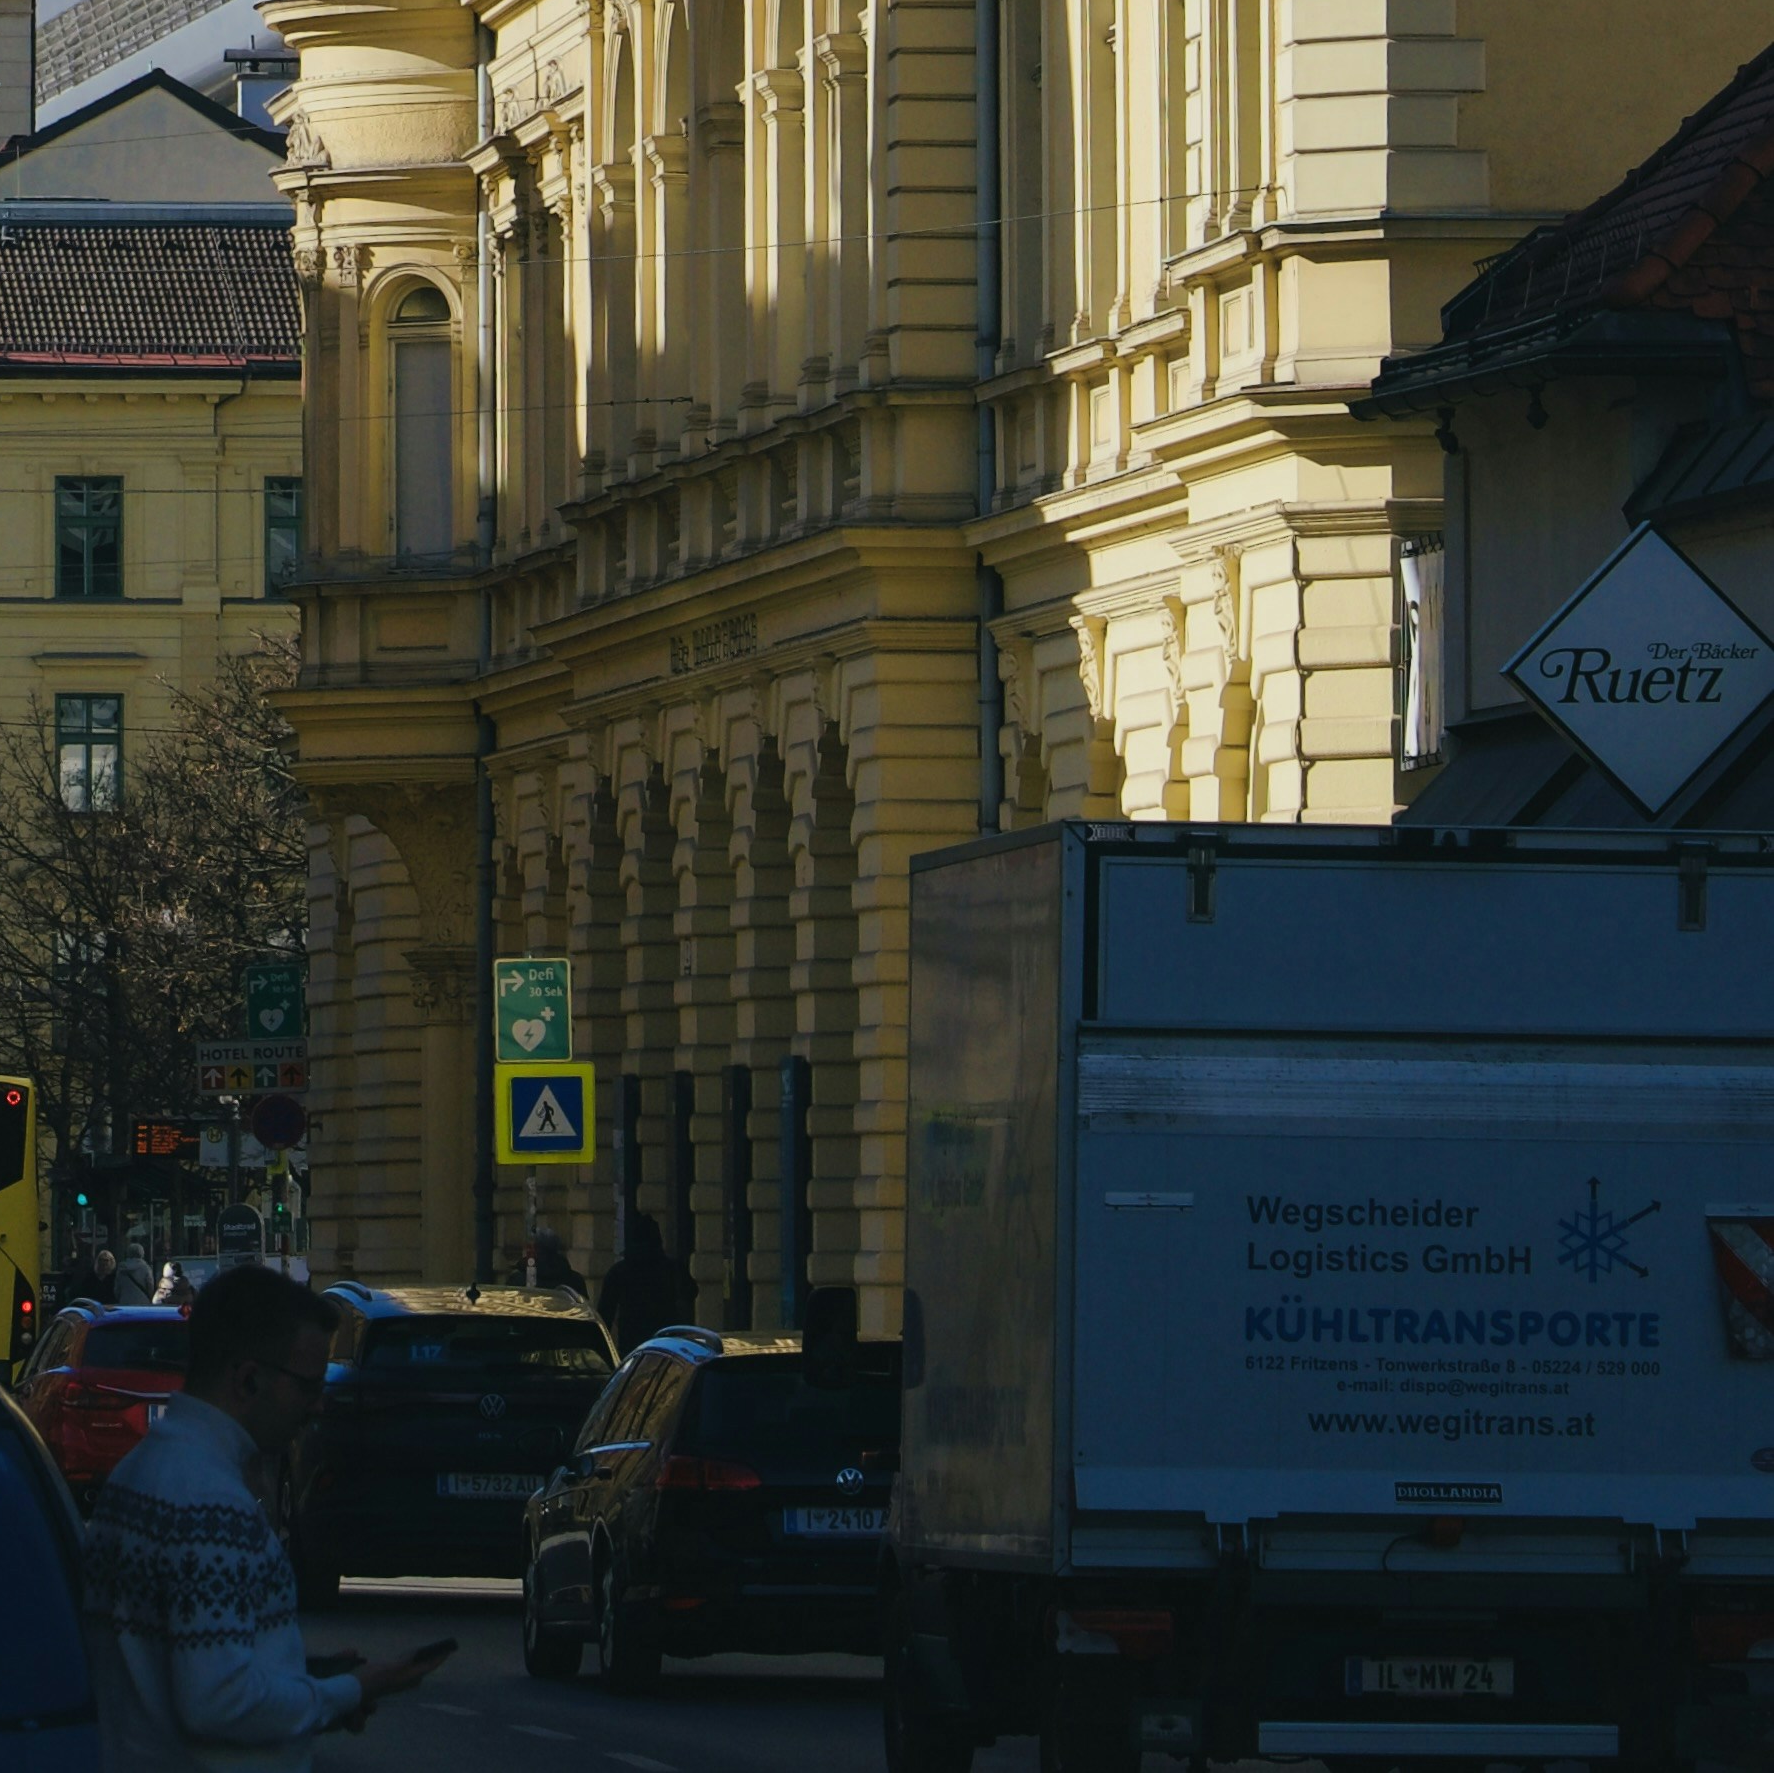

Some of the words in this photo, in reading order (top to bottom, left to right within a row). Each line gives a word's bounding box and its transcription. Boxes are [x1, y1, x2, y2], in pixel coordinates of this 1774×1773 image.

[1647, 642, 1688, 660] Der
[1691, 642, 1759, 660] Bäcker
[1539, 647, 1724, 704] Ruetz
[528, 966, 555, 981] Defi
[529, 986, 543, 998] 30
[544, 986, 563, 997] Sek
[200, 1048, 249, 1061] HOTEL
[253, 1046, 304, 1060] ROUTE
[1246, 1195, 1479, 1233] Wegscheider
[1247, 1242, 1409, 1279] Logistics
[1422, 1244, 1532, 1275] GmbH
[1245, 1294, 1660, 1348] KÜHLTRANSPORTE
[1245, 1355, 1285, 1371] 6122
[1290, 1356, 1359, 1371] Fritzens
[1375, 1357, 1501, 1374] Tonwerkstraße
[1506, 1359, 1516, 1374] 8
[1532, 1359, 1582, 1375] 05224
[1585, 1360, 1592, 1375] /
[1596, 1360, 1626, 1376] 529
[1630, 1361, 1661, 1376] 000
[1336, 1378, 1395, 1393] e-mail:
[1399, 1378, 1570, 1397] dispo@wegitrans.at
[1308, 1408, 1596, 1442] www.wegitrans.at
[471, 1476, 512, 1492] 5732
[1396, 1485, 1501, 1499] DHOLLANDIA
[827, 1508, 874, 1530] 2410
[1378, 1663, 1400, 1690] IL
[1420, 1663, 1457, 1690] MW
[1463, 1663, 1494, 1691] 24
